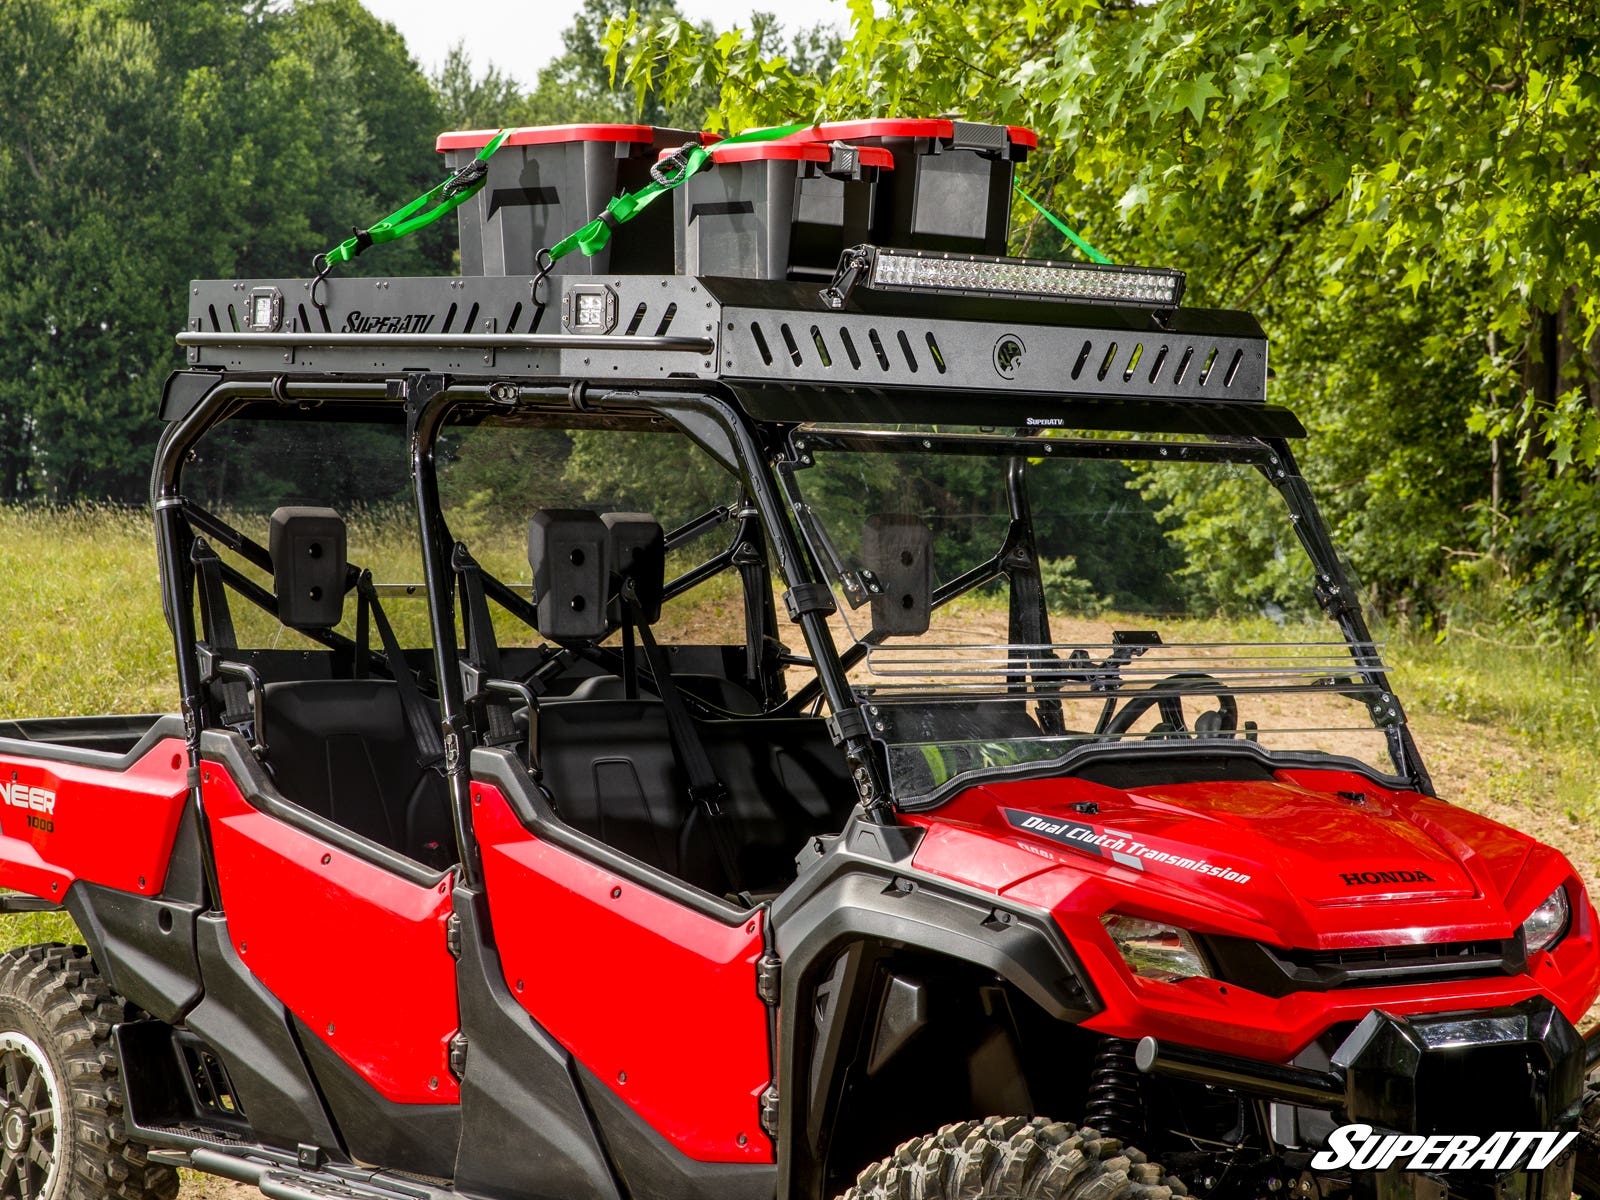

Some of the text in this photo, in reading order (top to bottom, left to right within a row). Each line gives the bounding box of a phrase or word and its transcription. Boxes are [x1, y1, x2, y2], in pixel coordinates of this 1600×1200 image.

[27, 815, 54, 833] 1000
[1021, 815, 1067, 836] Dual
[1066, 826, 1124, 851] Clutch
[1124, 841, 1251, 885] Transmission
[1338, 870, 1436, 886] HONDA
